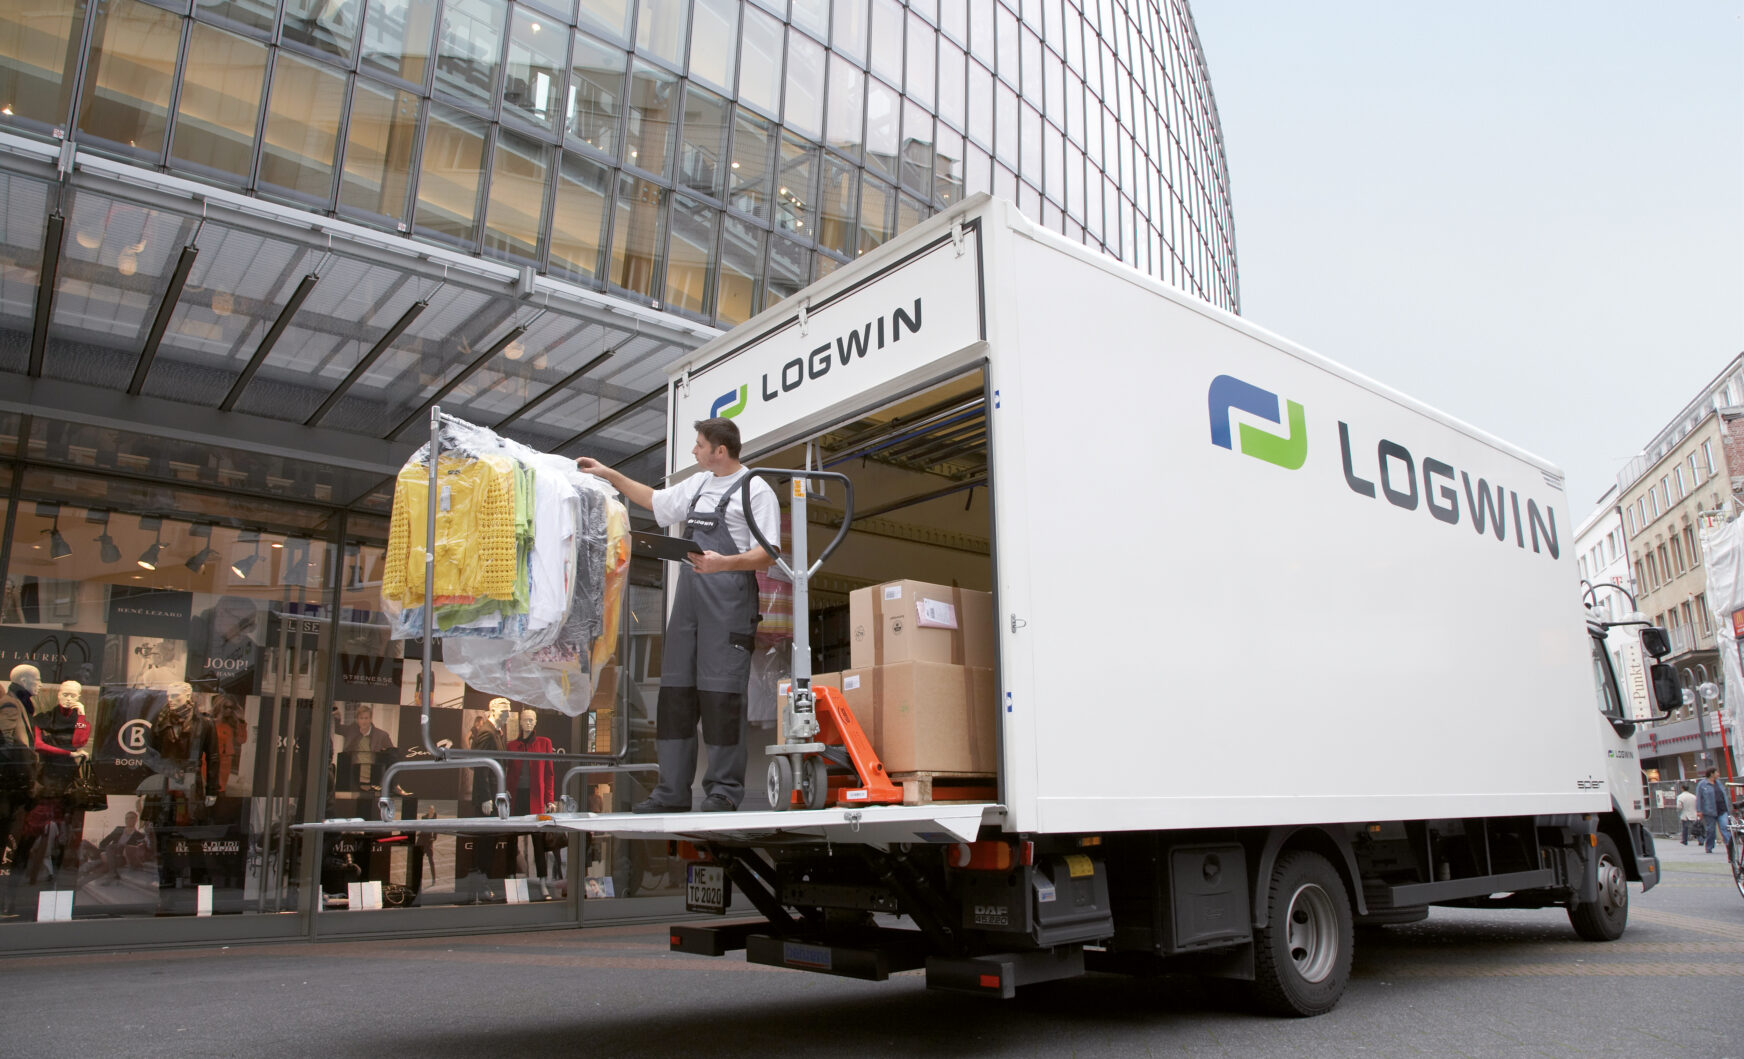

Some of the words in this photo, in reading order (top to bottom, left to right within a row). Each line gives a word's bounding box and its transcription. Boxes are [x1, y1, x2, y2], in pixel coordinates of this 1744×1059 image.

[762, 297, 922, 402] LOGWIN
[1338, 420, 1560, 560] LOGWIN
[203, 657, 249, 671] JOOP!
[1630, 663, 1646, 699] Punkt
[115, 758, 143, 766] BOGN
[1616, 750, 1634, 759] LOGWIN
[694, 867, 706, 884] ME
[690, 886, 700, 902] TC
[701, 887, 721, 904] 2020
[974, 905, 1008, 915] DAF
